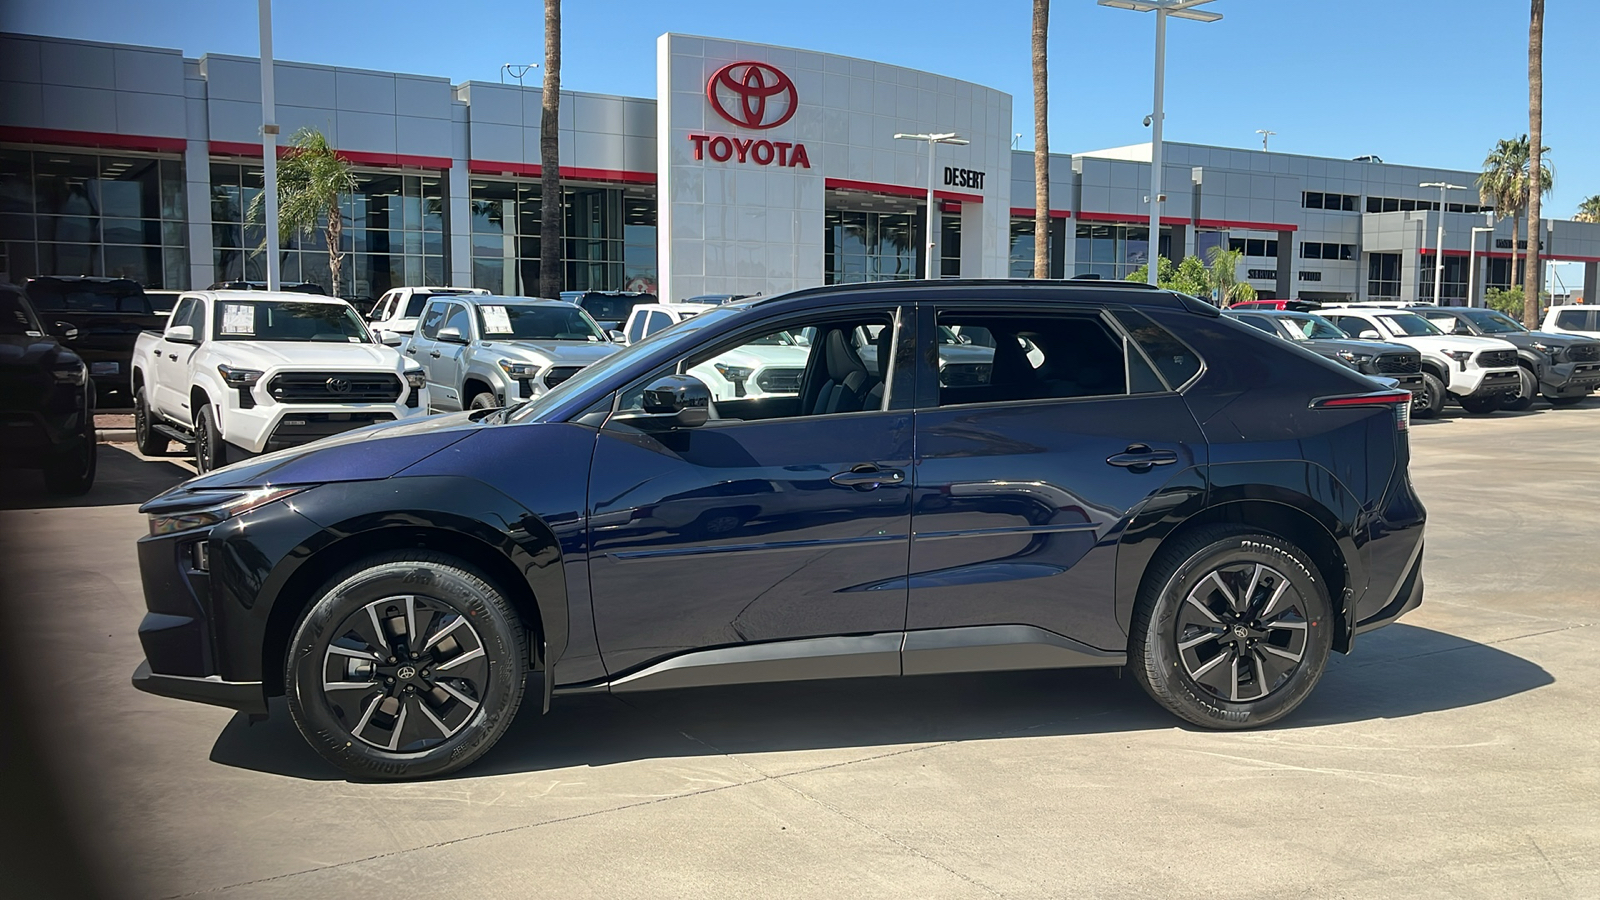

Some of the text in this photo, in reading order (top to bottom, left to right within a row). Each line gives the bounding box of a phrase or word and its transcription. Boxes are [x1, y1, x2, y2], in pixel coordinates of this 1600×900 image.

[688, 134, 811, 168] TOYOTA
[944, 166, 985, 190] DESERT
[1247, 269, 1278, 280] SERVIC
